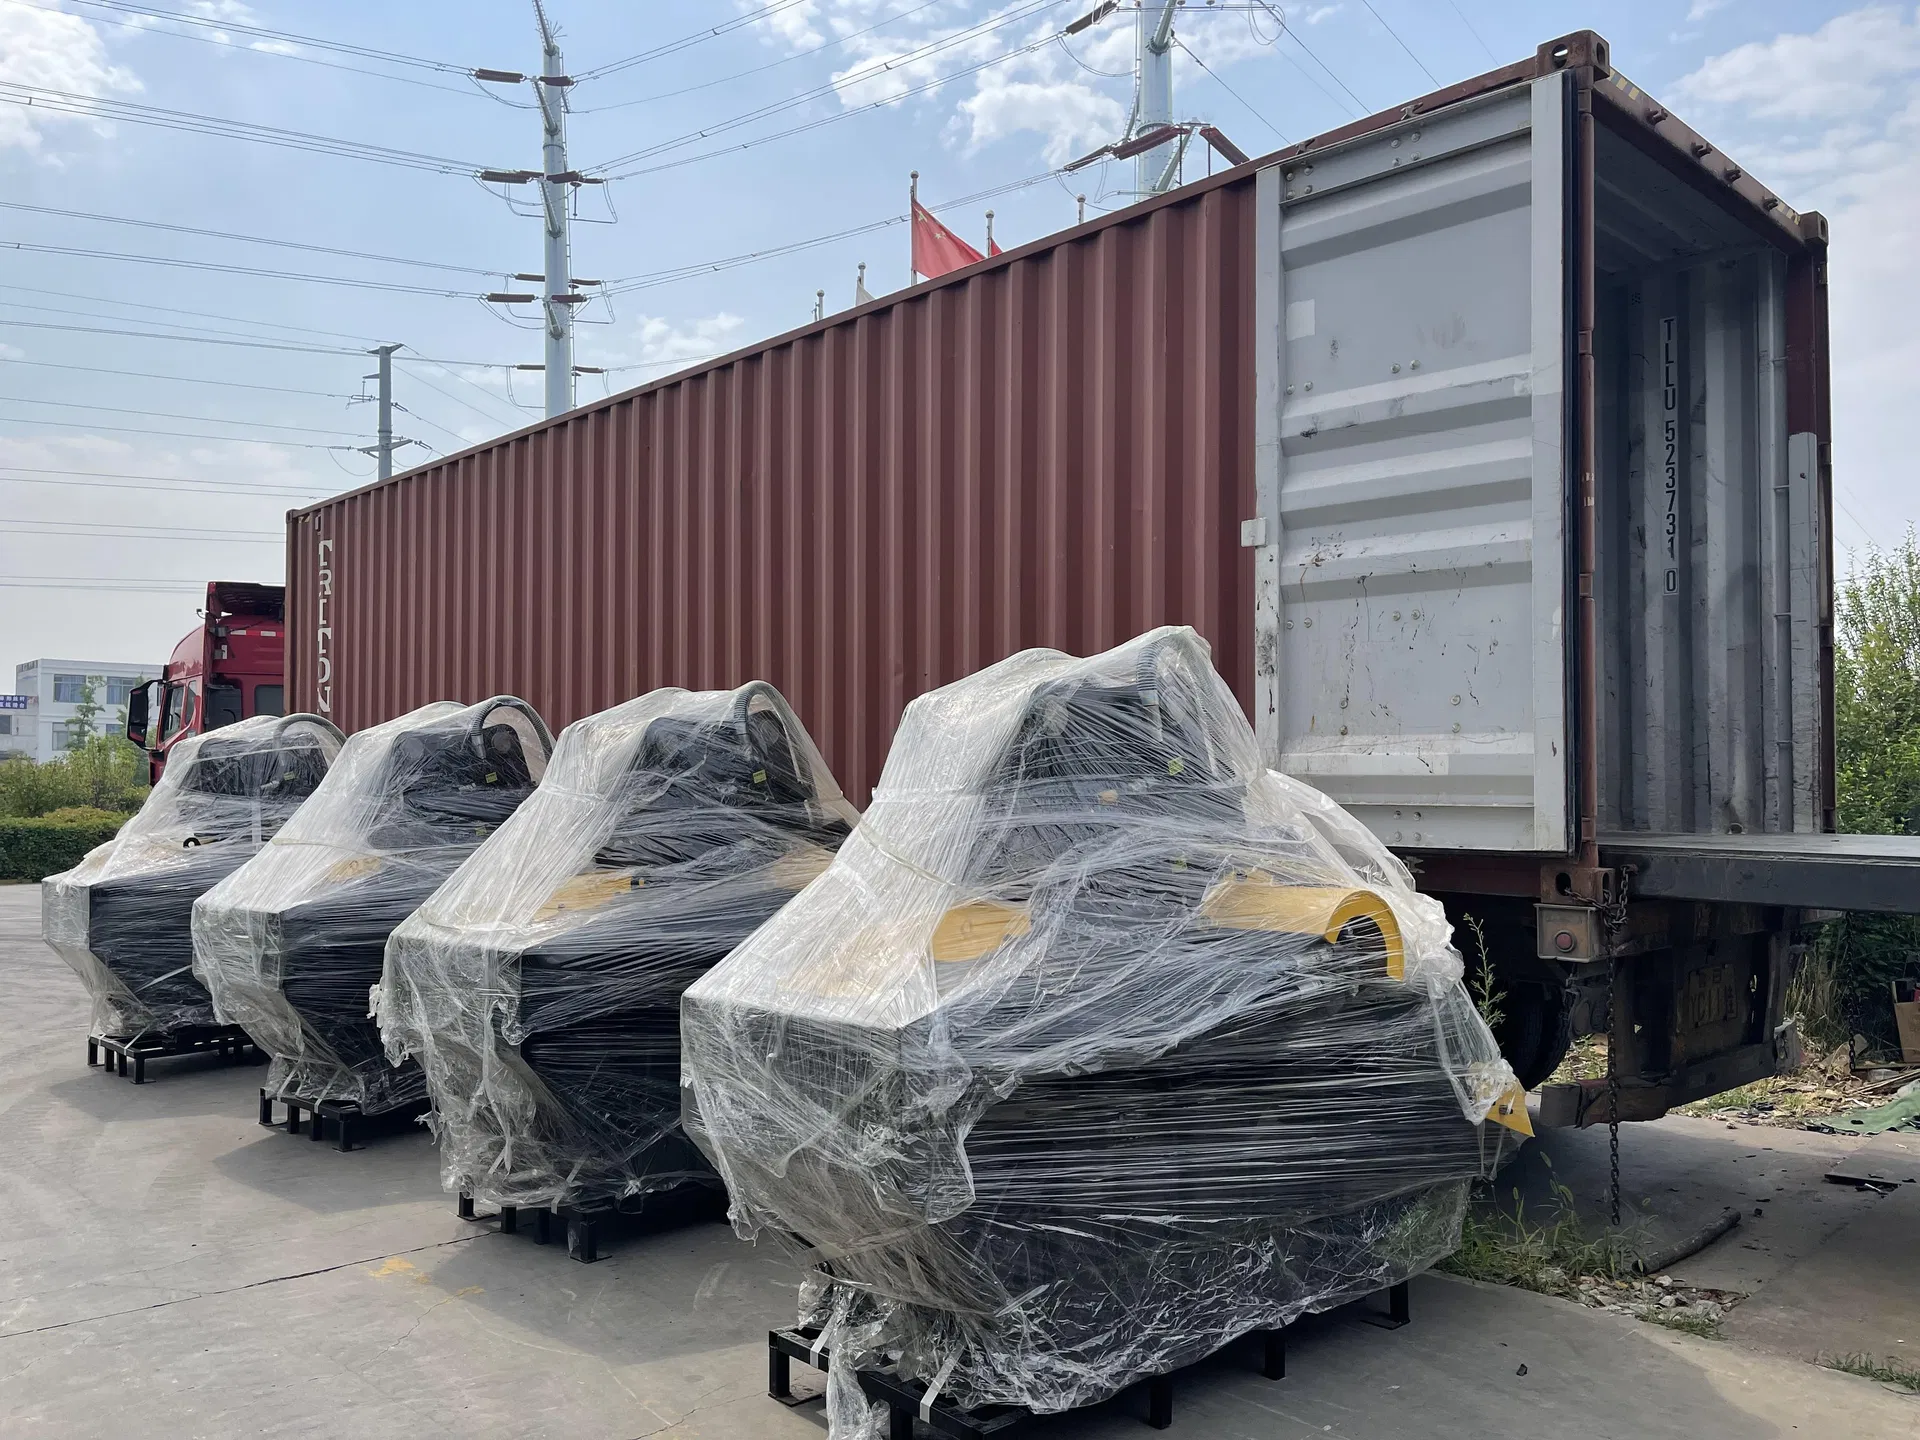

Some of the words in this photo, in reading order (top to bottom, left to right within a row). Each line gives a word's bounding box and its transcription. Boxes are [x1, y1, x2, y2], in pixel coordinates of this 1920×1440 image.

[1663, 318, 1677, 411] TLLU
[1664, 419, 1677, 562] 523731
[1665, 569, 1677, 593] 0
